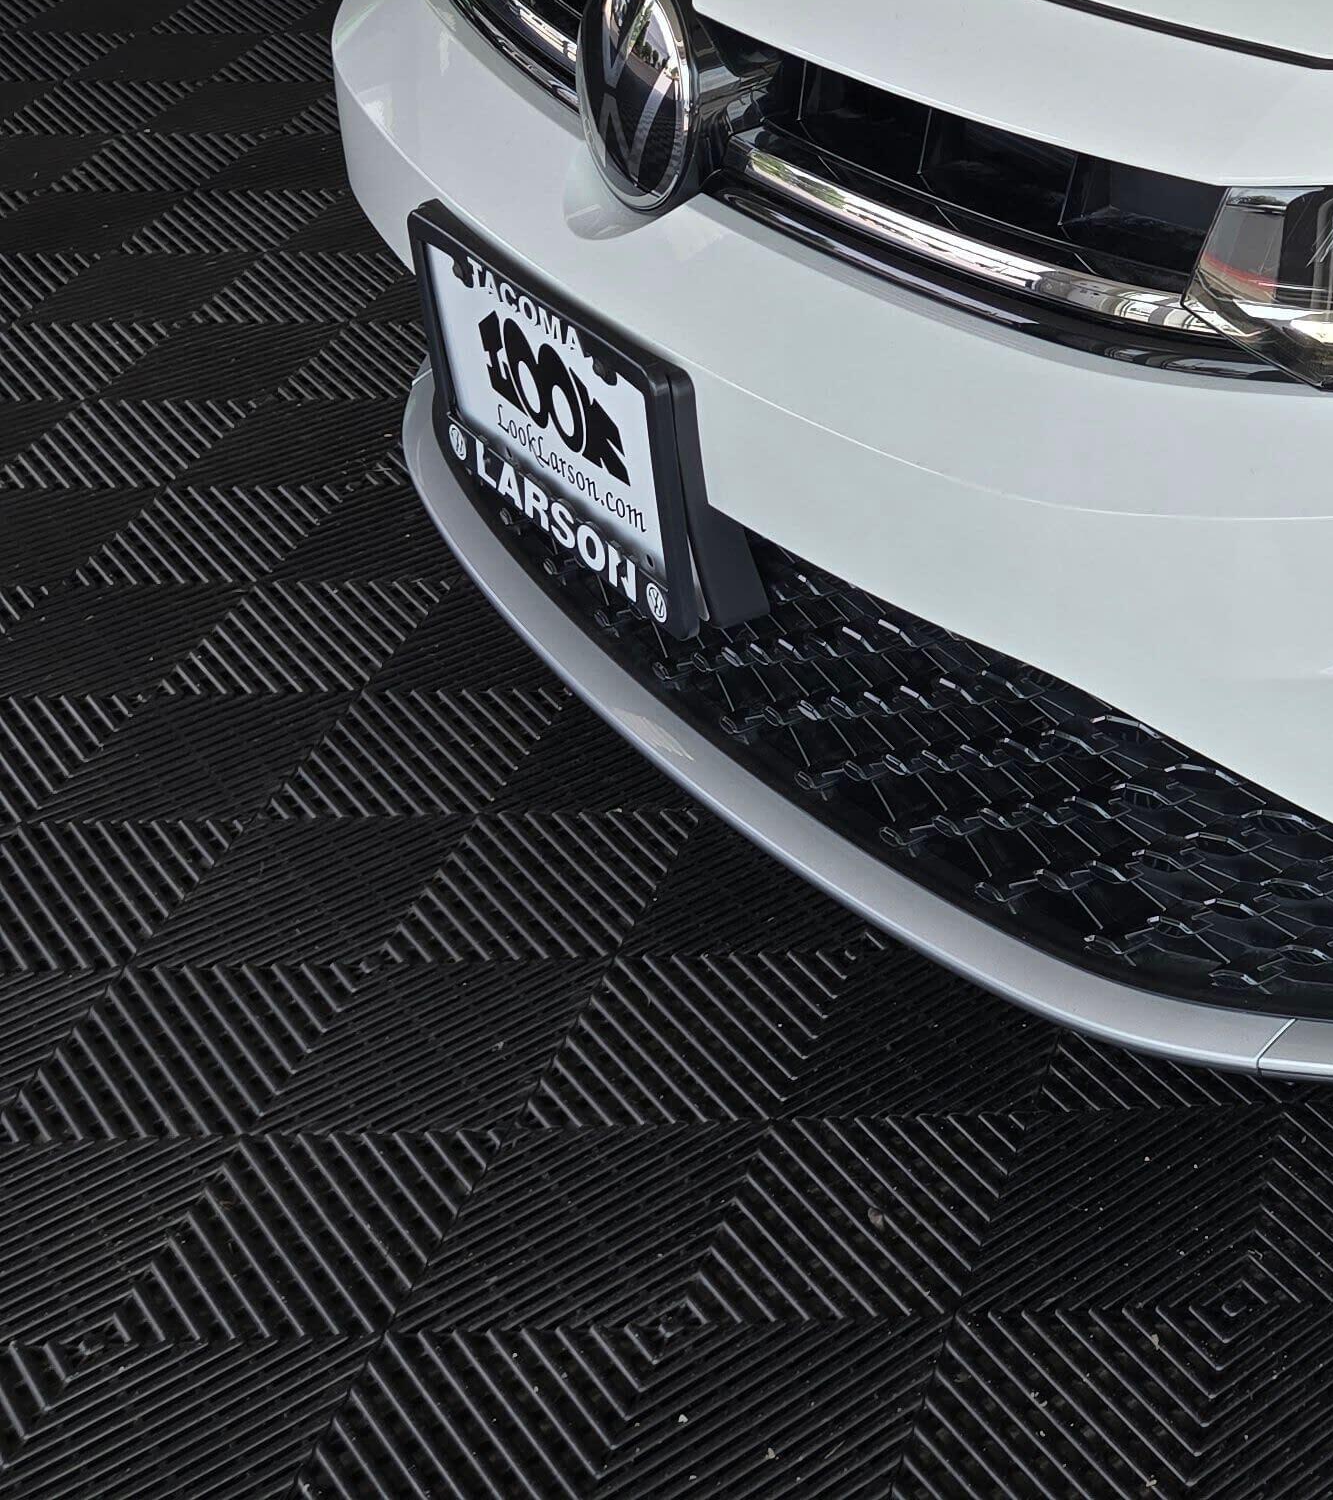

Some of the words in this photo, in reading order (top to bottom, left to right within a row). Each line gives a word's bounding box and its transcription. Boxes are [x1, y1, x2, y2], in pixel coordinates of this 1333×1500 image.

[467, 256, 584, 358] TACOMA
[478, 309, 632, 486] LOOK
[497, 403, 647, 534] LookLarson.com
[476, 438, 638, 602] LARSON
